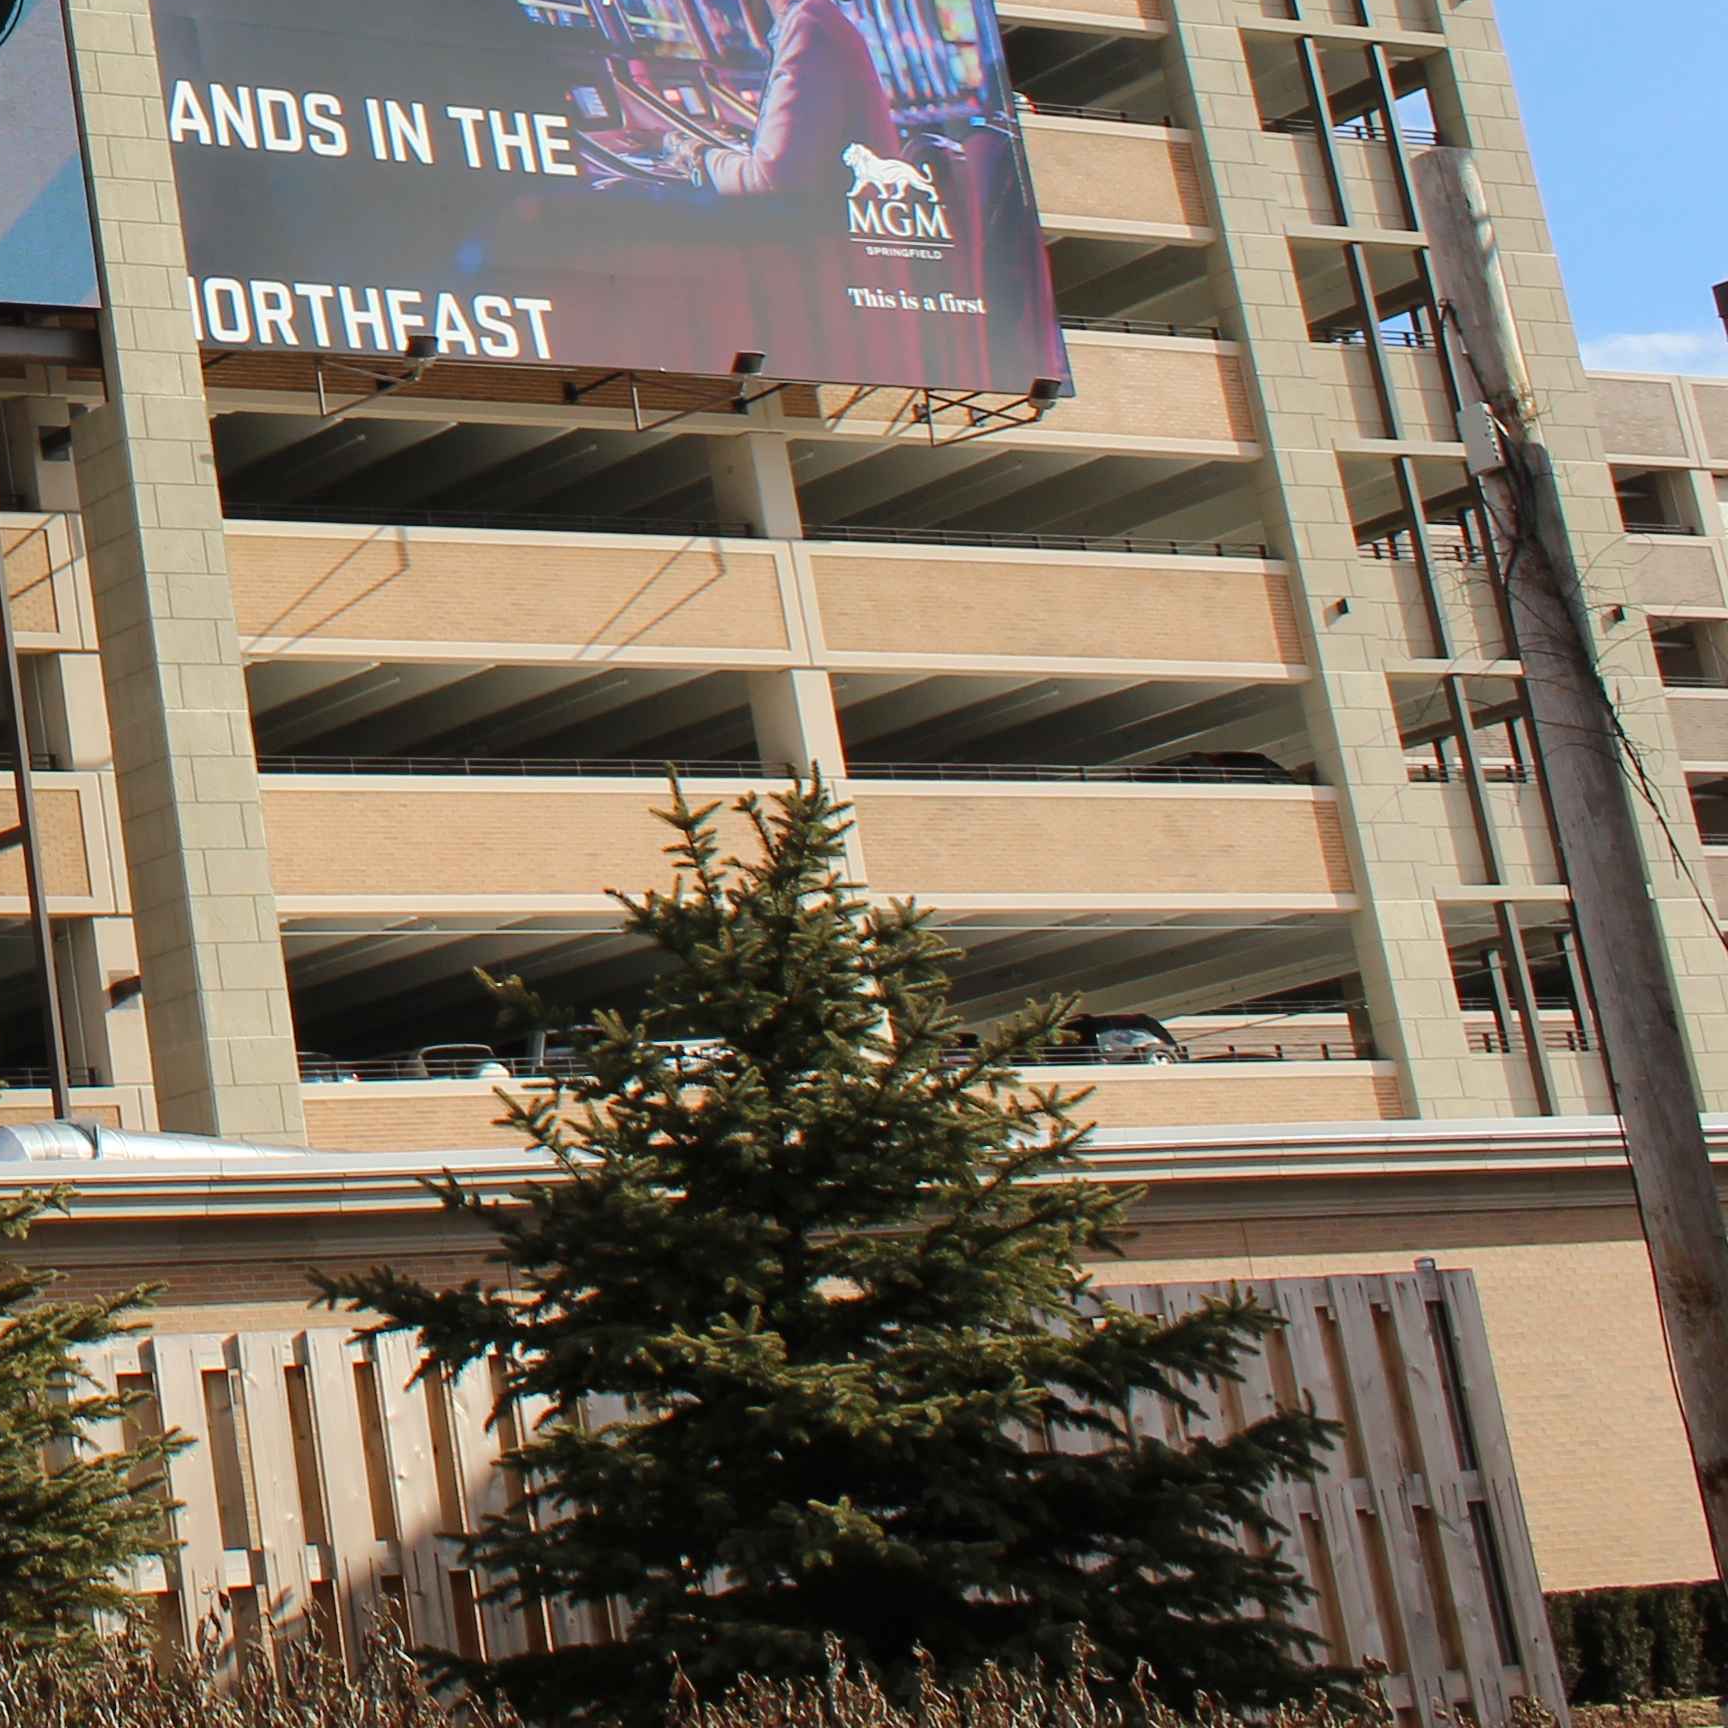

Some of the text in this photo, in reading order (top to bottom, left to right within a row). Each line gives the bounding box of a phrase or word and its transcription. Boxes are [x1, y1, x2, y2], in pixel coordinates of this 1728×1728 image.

[365, 98, 434, 165] IN
[447, 106, 578, 176] THE
[848, 199, 953, 240] MGM
[864, 246, 943, 260] SPRINGFIELD
[848, 288, 987, 315] This is a first
